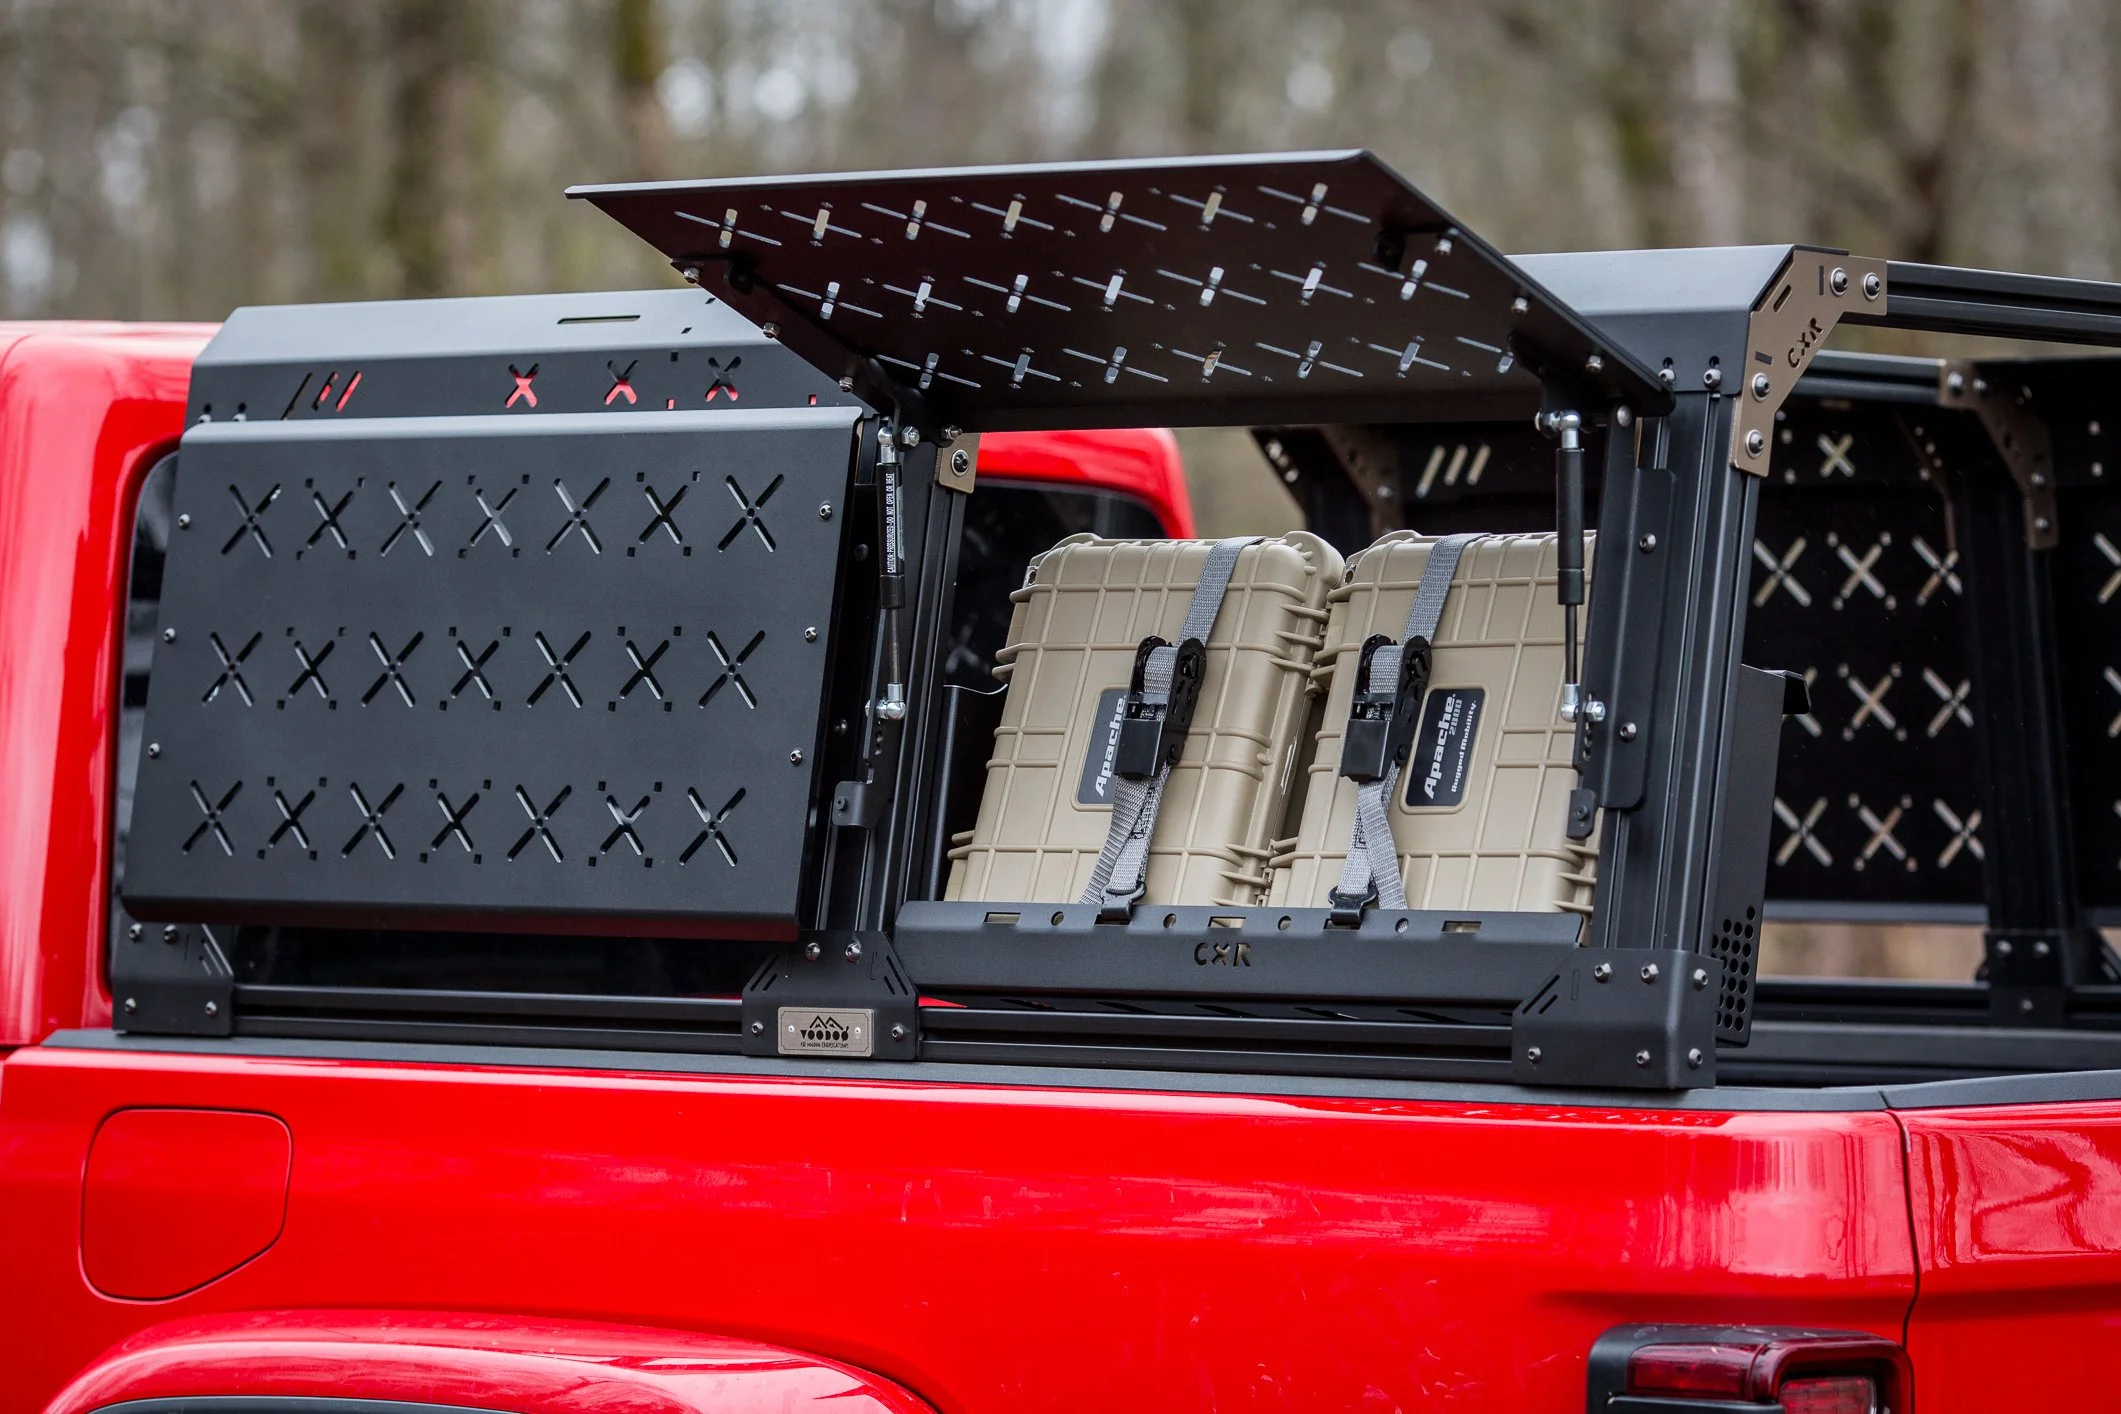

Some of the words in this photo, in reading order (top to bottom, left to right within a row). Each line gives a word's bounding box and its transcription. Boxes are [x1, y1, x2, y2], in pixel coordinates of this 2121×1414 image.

[1788, 317, 1823, 368] CXR
[1449, 699, 1462, 735] 2800
[1451, 751, 1464, 793] Rugged
[1194, 942, 1251, 967] CXR
